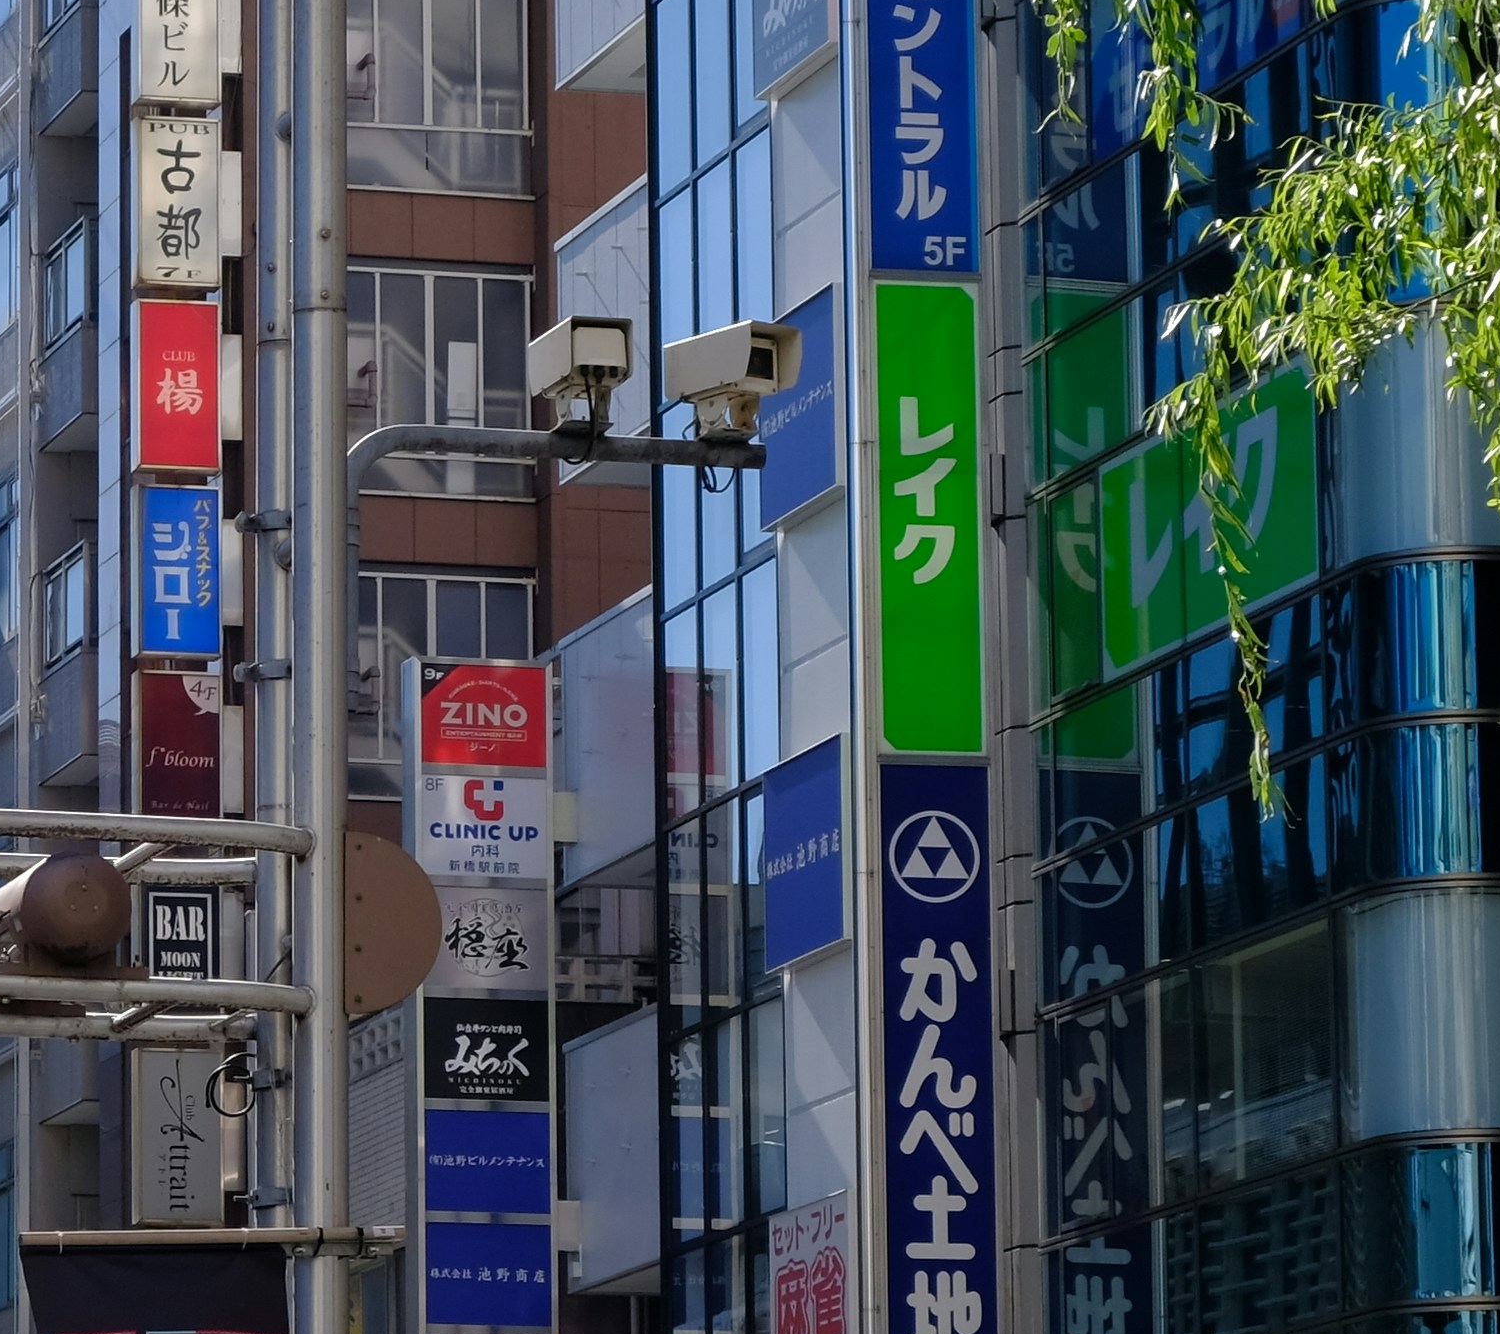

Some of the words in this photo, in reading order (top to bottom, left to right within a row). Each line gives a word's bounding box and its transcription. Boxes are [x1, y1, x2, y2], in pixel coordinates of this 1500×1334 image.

[146, 121, 212, 137] PUB
[155, 139, 203, 260] 古都
[922, 236, 967, 267] 5F
[161, 349, 197, 363] CLUB
[893, 394, 956, 586] レイク
[151, 521, 193, 641] ジロー
[424, 668, 445, 681] 9F
[188, 680, 219, 702] 4F
[439, 701, 529, 729] ZINO
[469, 741, 498, 753] ジーノ
[424, 777, 445, 792] 8F
[429, 821, 503, 842] CLINIC
[508, 824, 540, 843] UP
[470, 844, 501, 858] 内科
[448, 859, 521, 875] 新橋駅前院
[155, 904, 207, 942] BAR
[159, 950, 202, 968] MOON
[444, 1034, 532, 1078] みちのく
[184, 1094, 195, 1122] Club
[771, 1205, 846, 1259] セット・フリー
[430, 1268, 473, 1281] 株式会社
[477, 1267, 546, 1284] 池野商店
